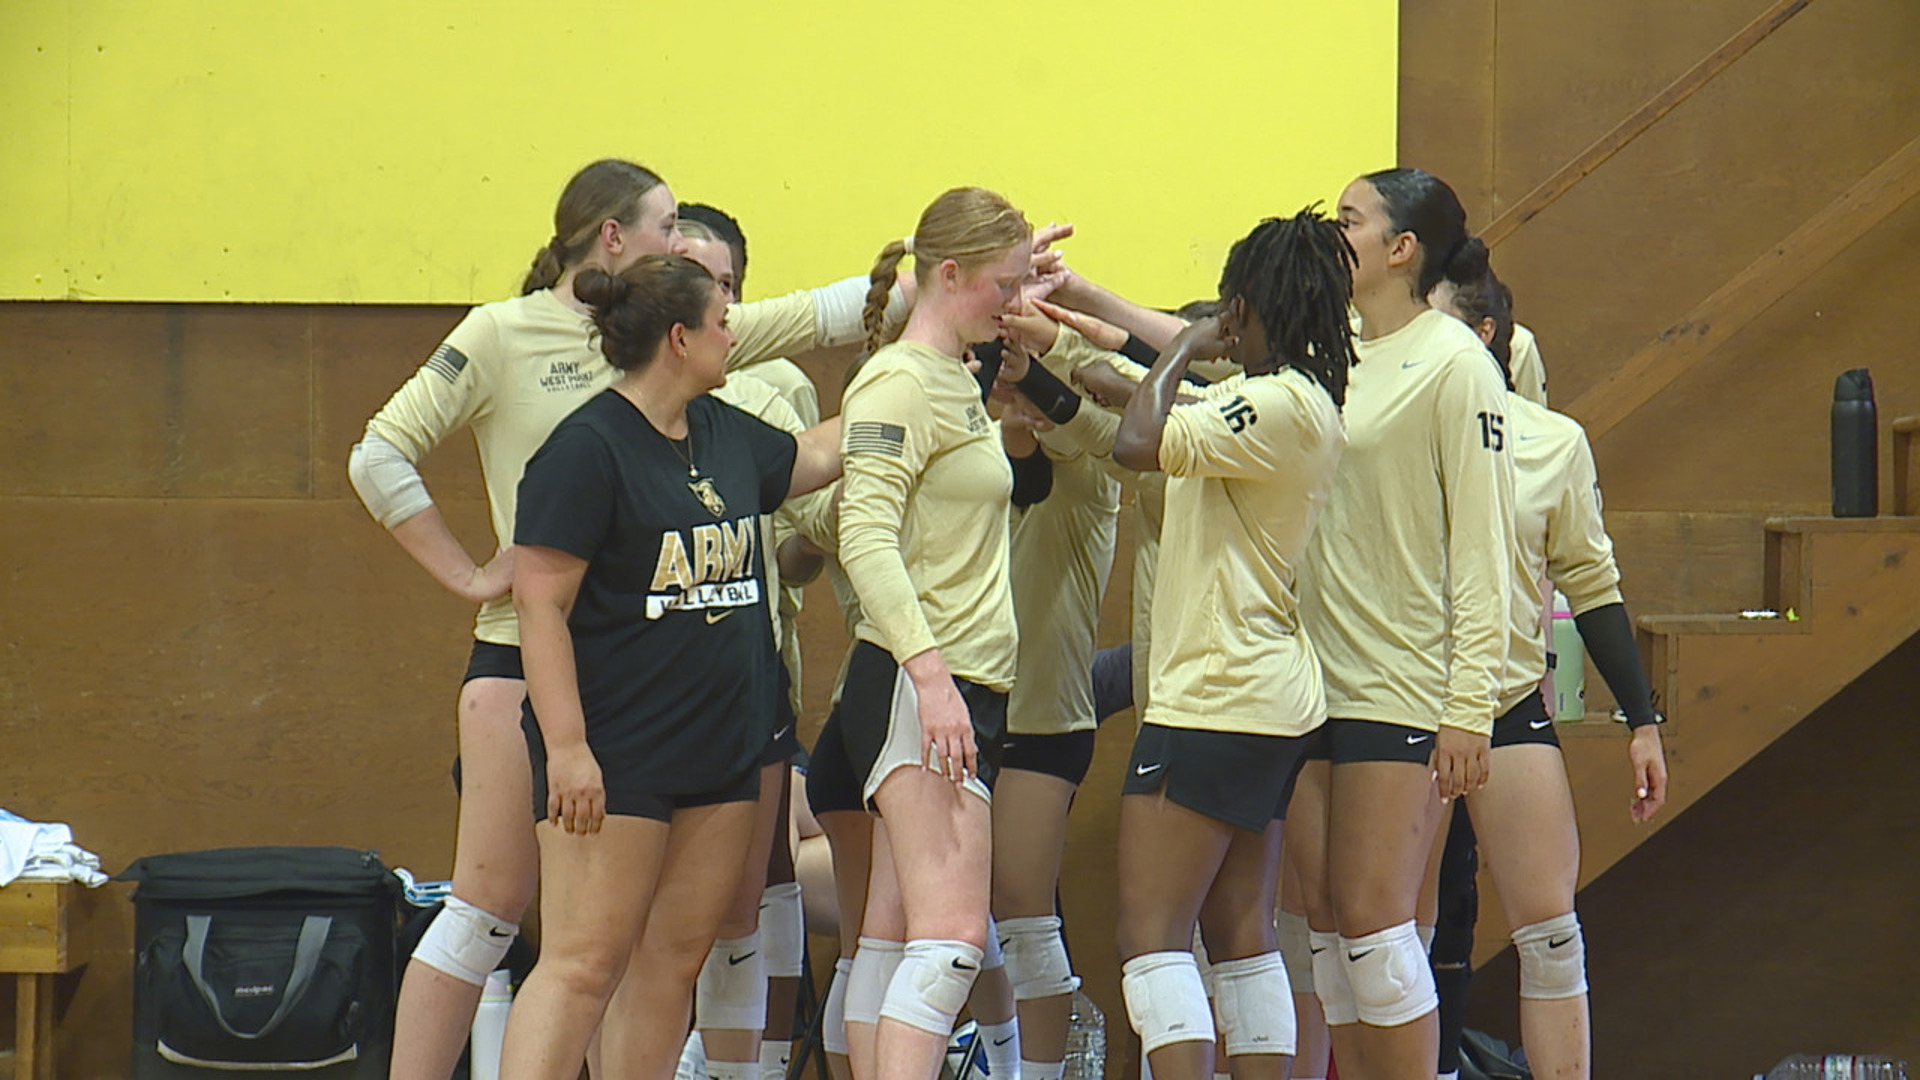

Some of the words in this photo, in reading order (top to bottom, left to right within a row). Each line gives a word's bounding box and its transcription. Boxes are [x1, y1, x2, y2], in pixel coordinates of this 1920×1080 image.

[540, 374, 566, 387] WEST
[550, 361, 580, 375] ARMY
[1219, 396, 1258, 434] 16
[1477, 411, 1504, 452] 15
[649, 515, 755, 591] ARMY
